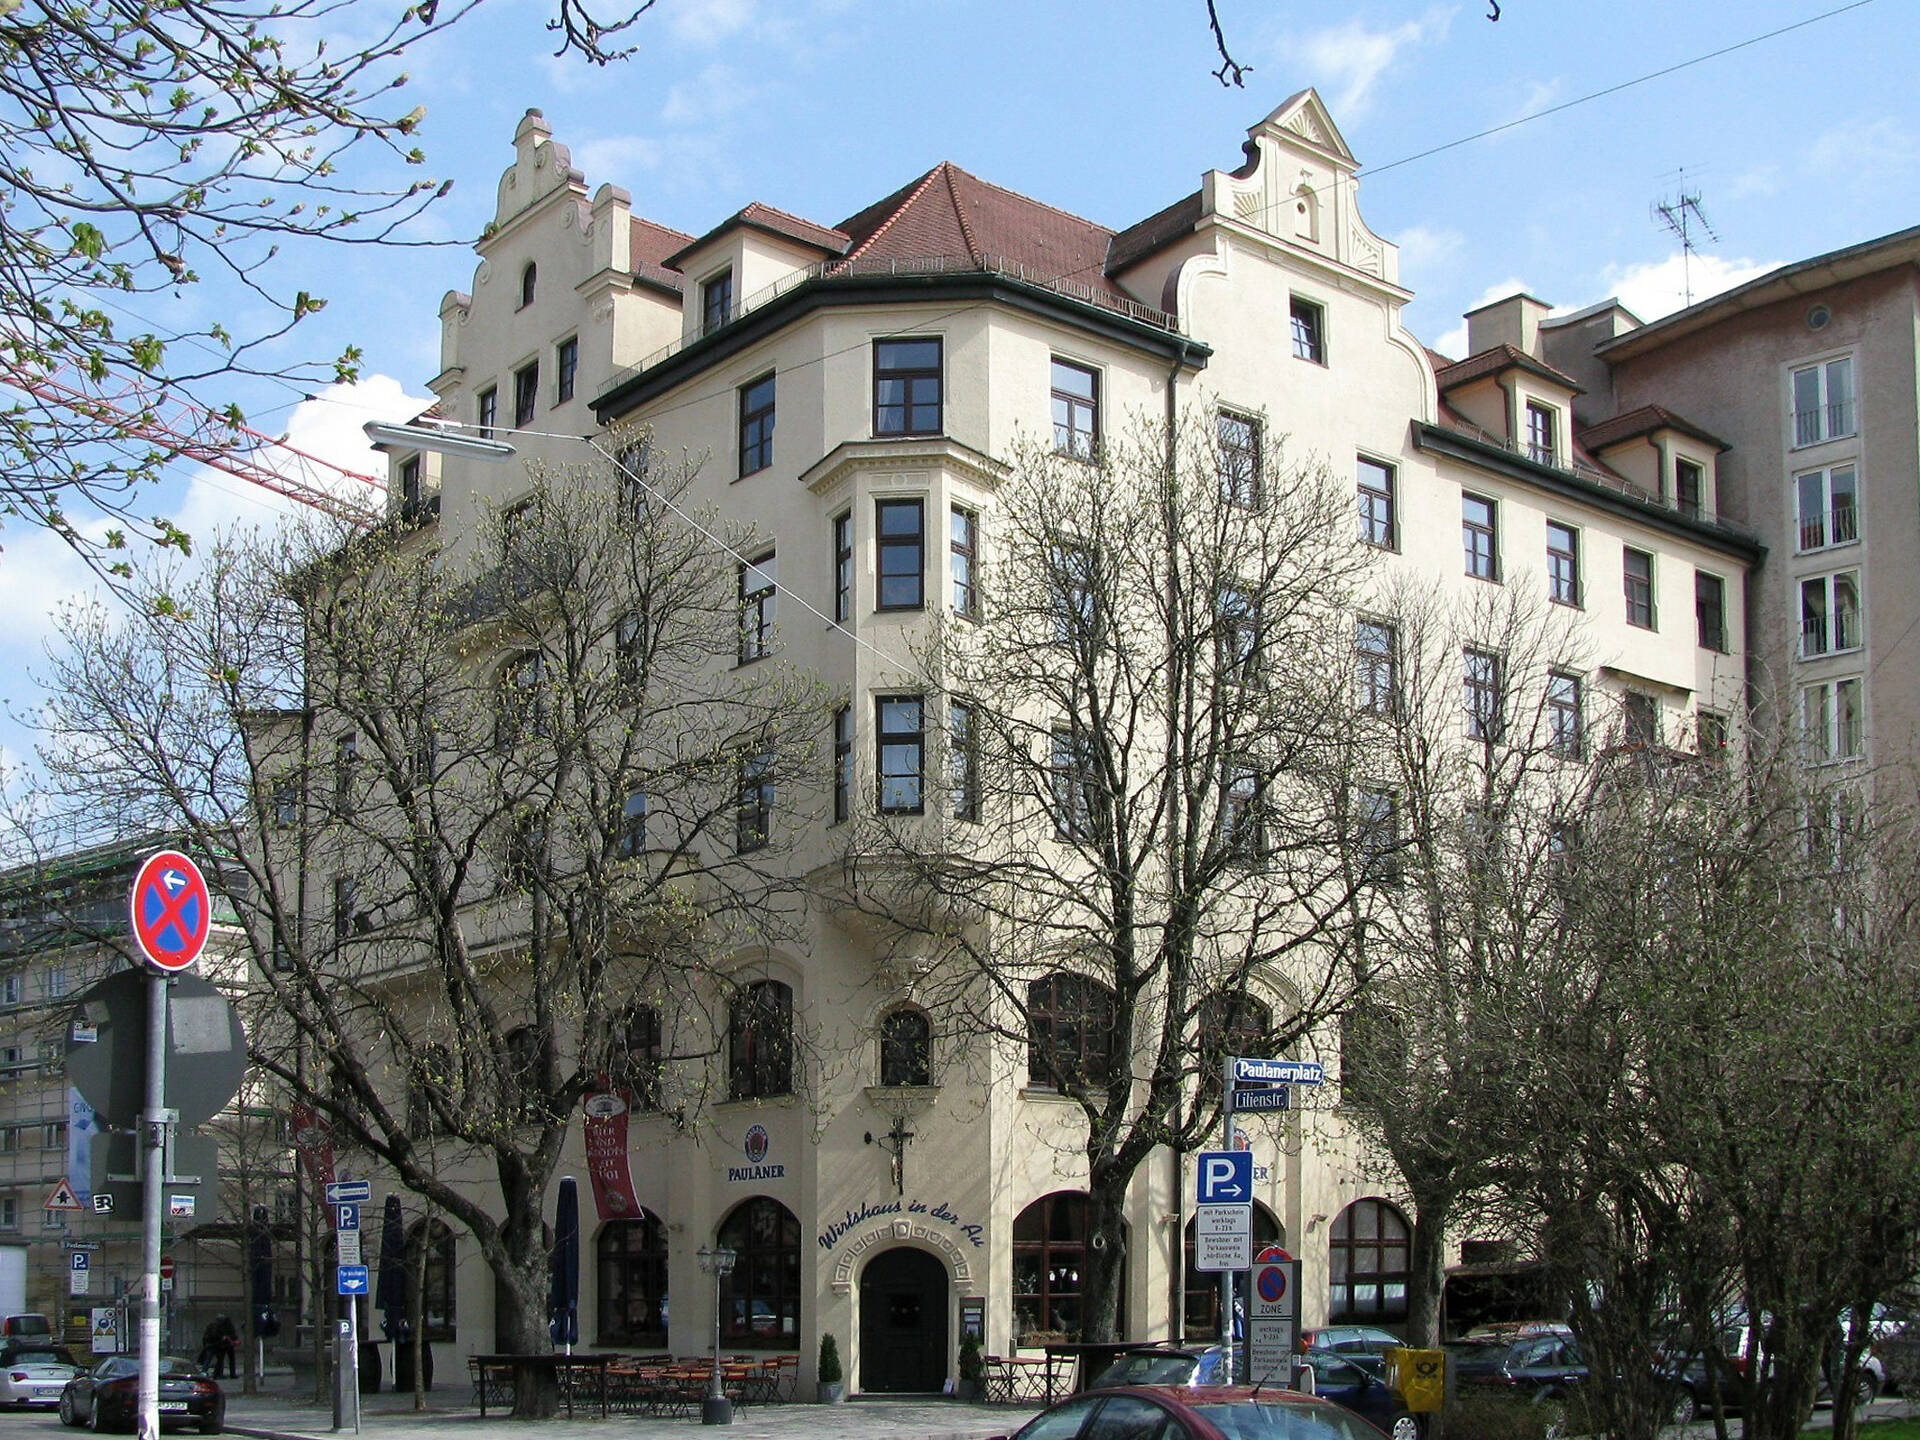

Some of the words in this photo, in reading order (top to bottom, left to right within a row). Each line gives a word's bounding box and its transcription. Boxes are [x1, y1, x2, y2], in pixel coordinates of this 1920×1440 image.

[1239, 1060, 1321, 1082] Paulanerplatz
[1235, 1092, 1284, 1108] Lilienstr.
[728, 1165, 785, 1181] PAULANER
[1205, 1159, 1236, 1197] P
[818, 1201, 902, 1249] Wirtshaus
[908, 1200, 927, 1213] in
[930, 1202, 959, 1224] der
[960, 1224, 984, 1248] Au
[1260, 1304, 1282, 1314] ZONE
